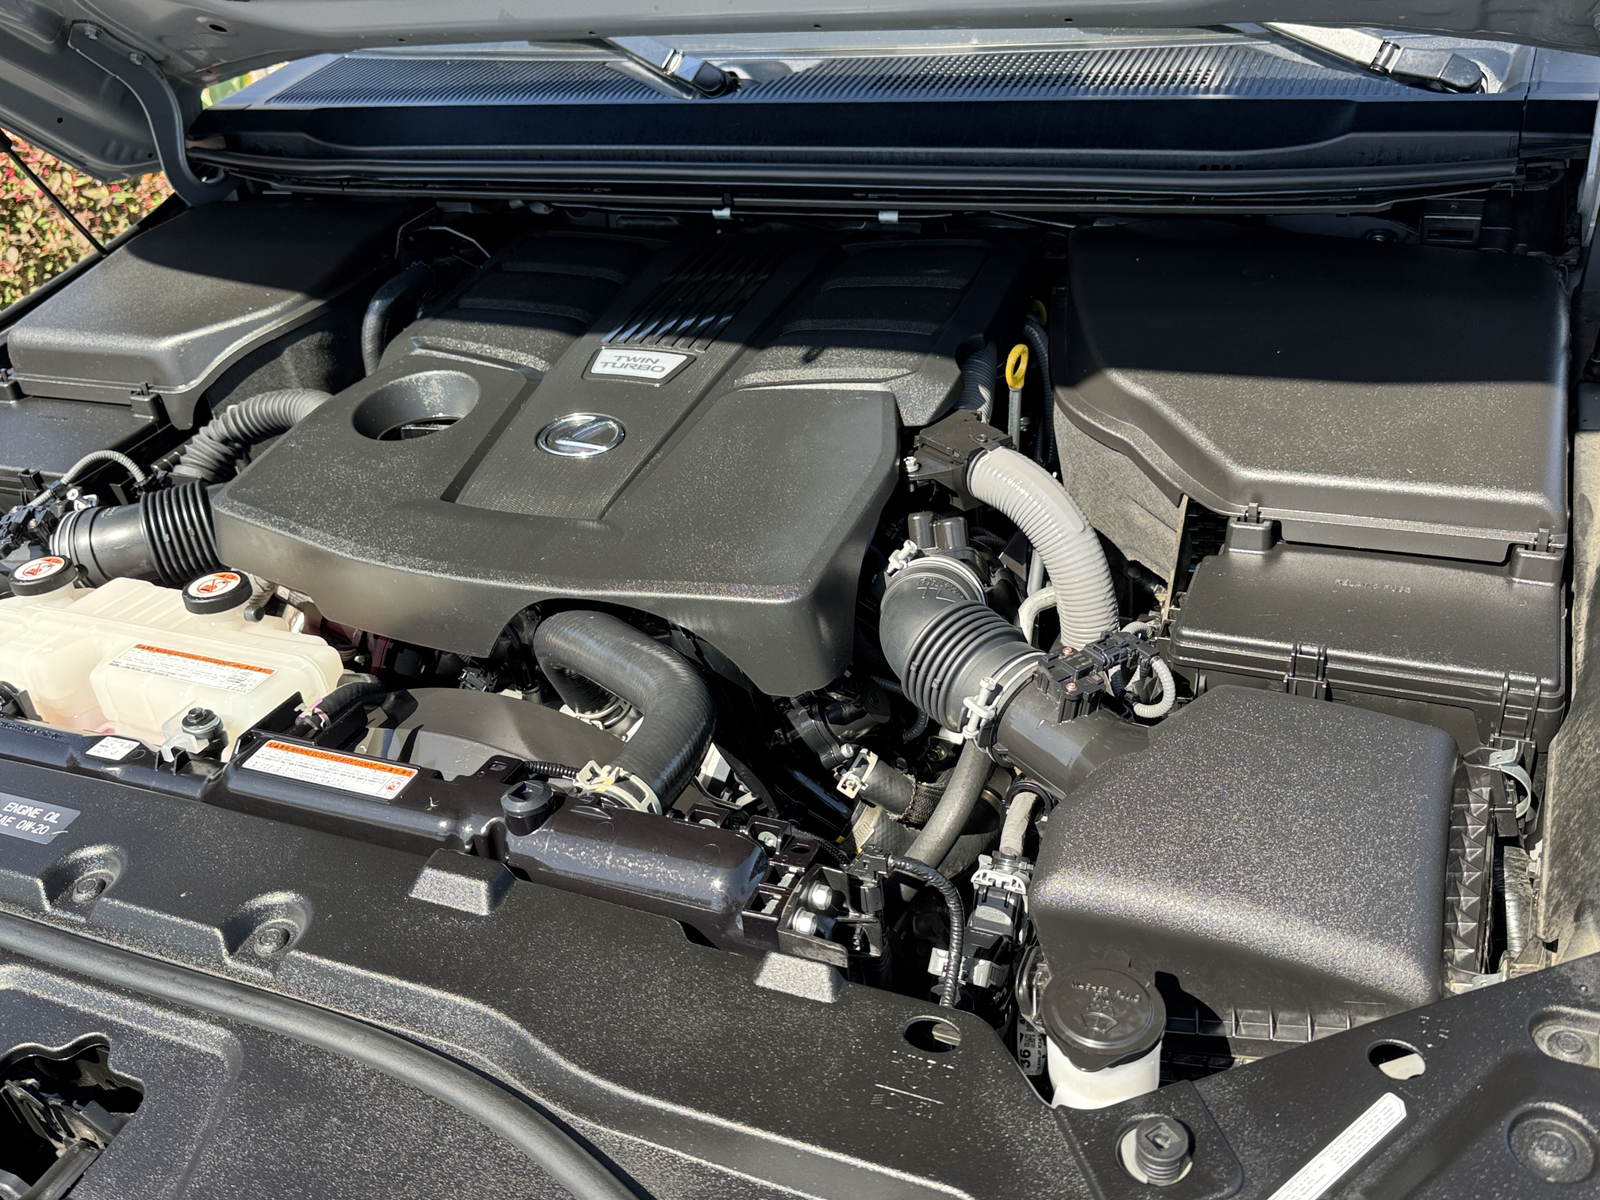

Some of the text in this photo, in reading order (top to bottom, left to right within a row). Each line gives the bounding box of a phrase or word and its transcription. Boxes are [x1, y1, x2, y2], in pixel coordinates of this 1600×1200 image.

[600, 361, 666, 373] TURBO
[613, 355, 660, 364] TWIN
[1334, 579, 1370, 589] RELAY
[1383, 584, 1412, 594] FUSE
[3, 801, 61, 824] ENGINE OIL
[15, 820, 51, 836] 0W-20
[1019, 1048, 1032, 1069] 36
